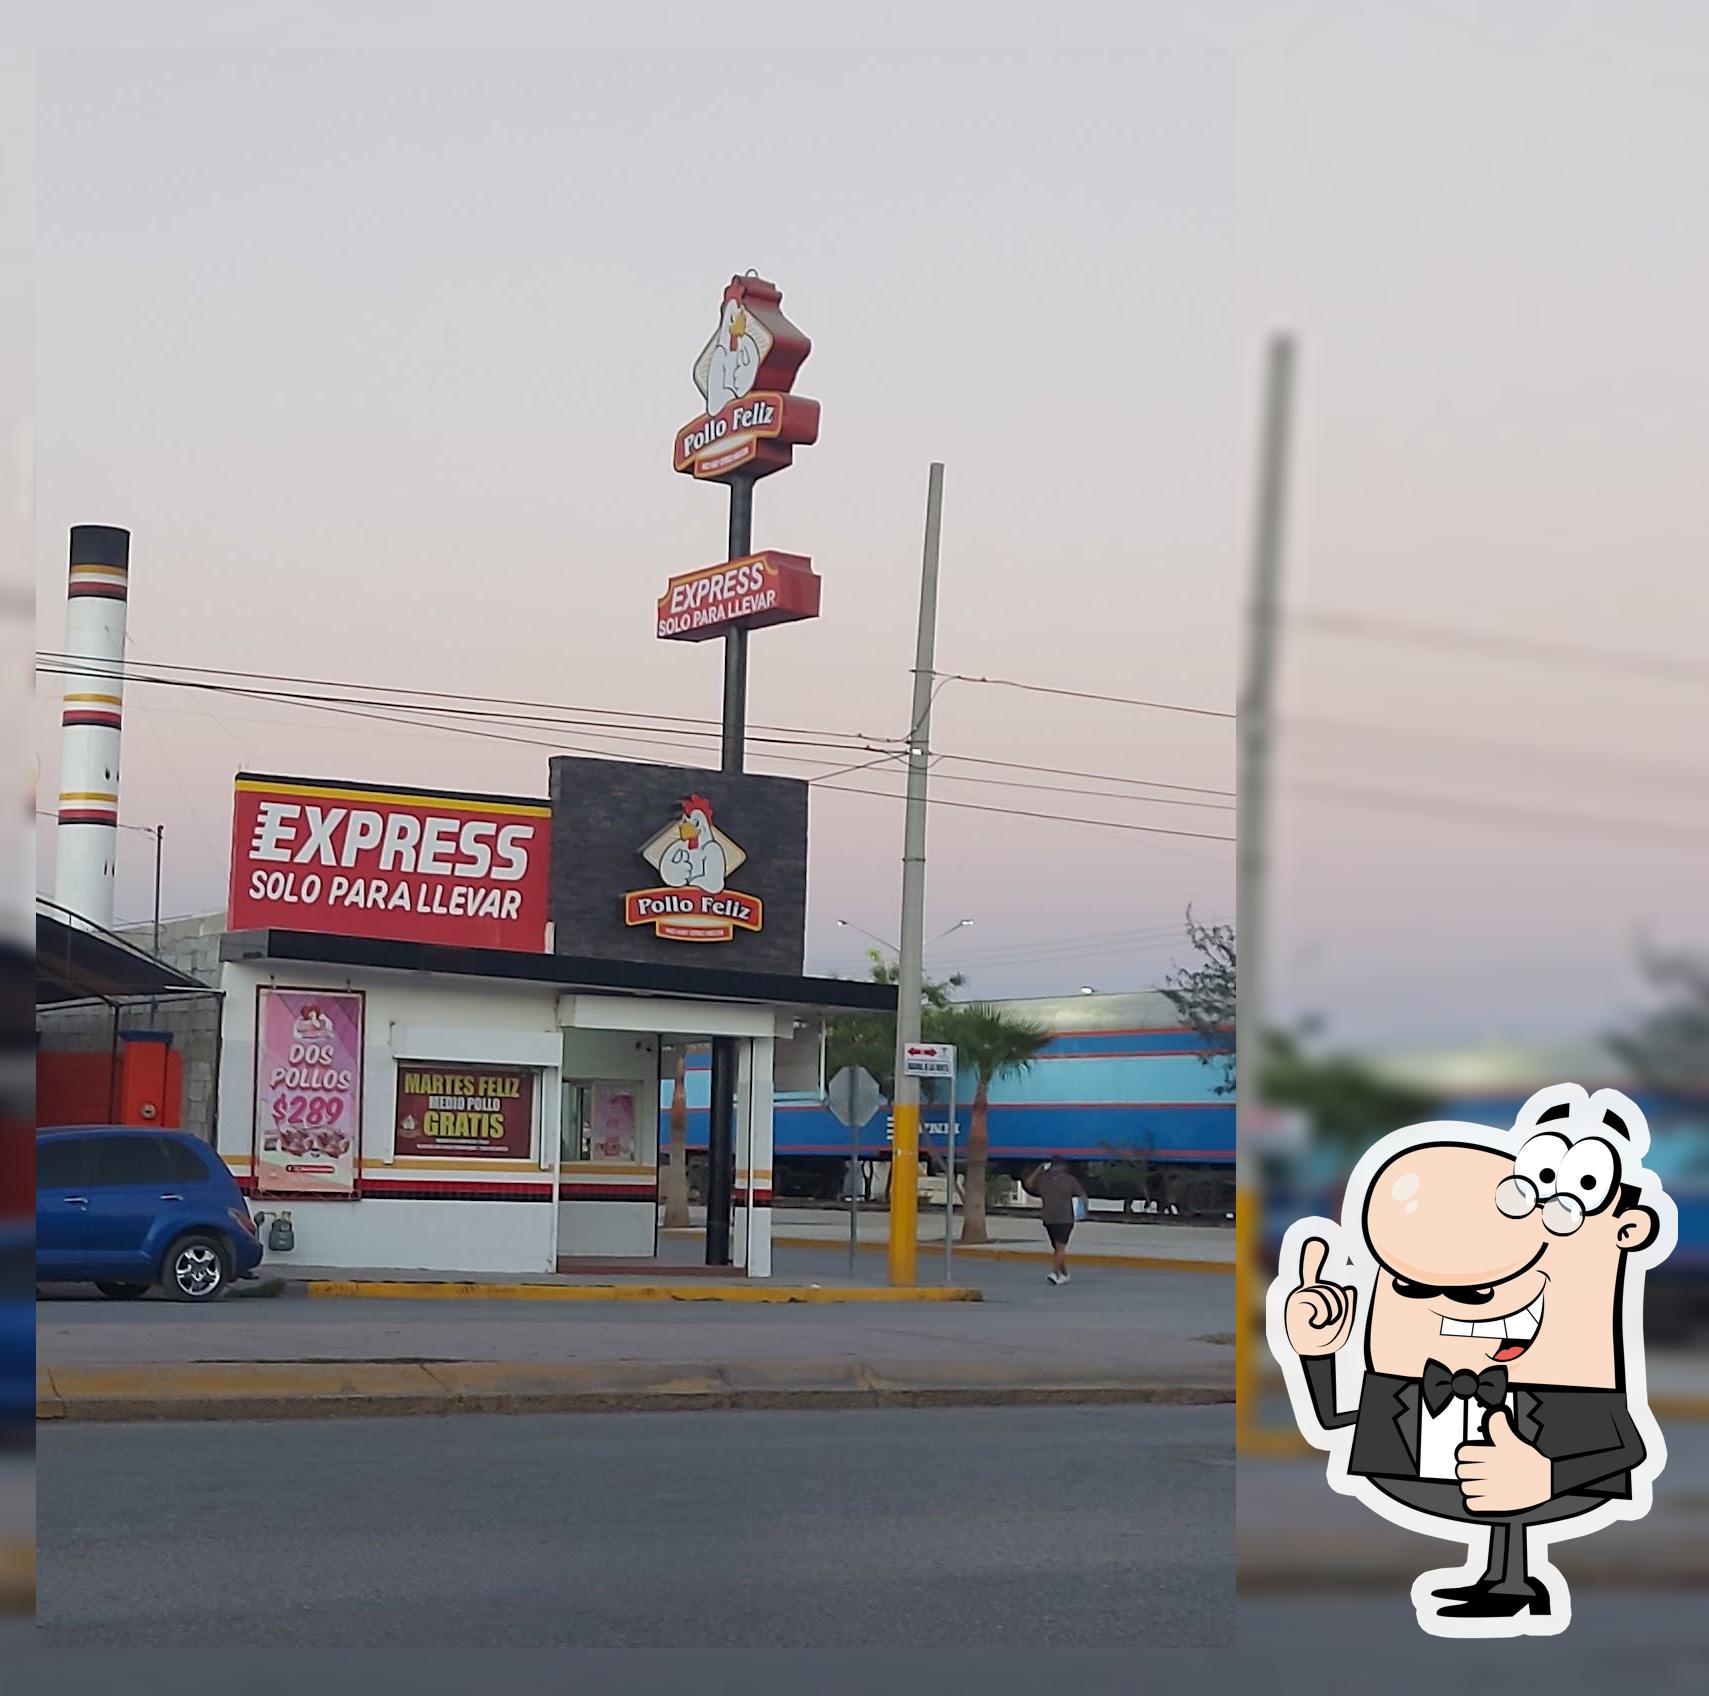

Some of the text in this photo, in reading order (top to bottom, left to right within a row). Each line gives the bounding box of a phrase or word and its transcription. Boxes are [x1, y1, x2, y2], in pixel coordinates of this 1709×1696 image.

[683, 404, 775, 458] Pollo Feliz
[669, 562, 764, 614] EXPRESS
[658, 589, 776, 638] SOLO PARA LLEVAR
[249, 801, 535, 881] EXPRESS
[248, 869, 522, 920] SOLO PARA LLEVAR
[637, 896, 751, 919] Pollo Feliz
[288, 1043, 334, 1066] DOS
[270, 1067, 352, 1091] POLLOS
[404, 1072, 520, 1098] MARTES FELIZ
[272, 1093, 345, 1126] $289
[428, 1095, 501, 1112] MEDIO POLLO
[423, 1111, 505, 1139] GRATIS
